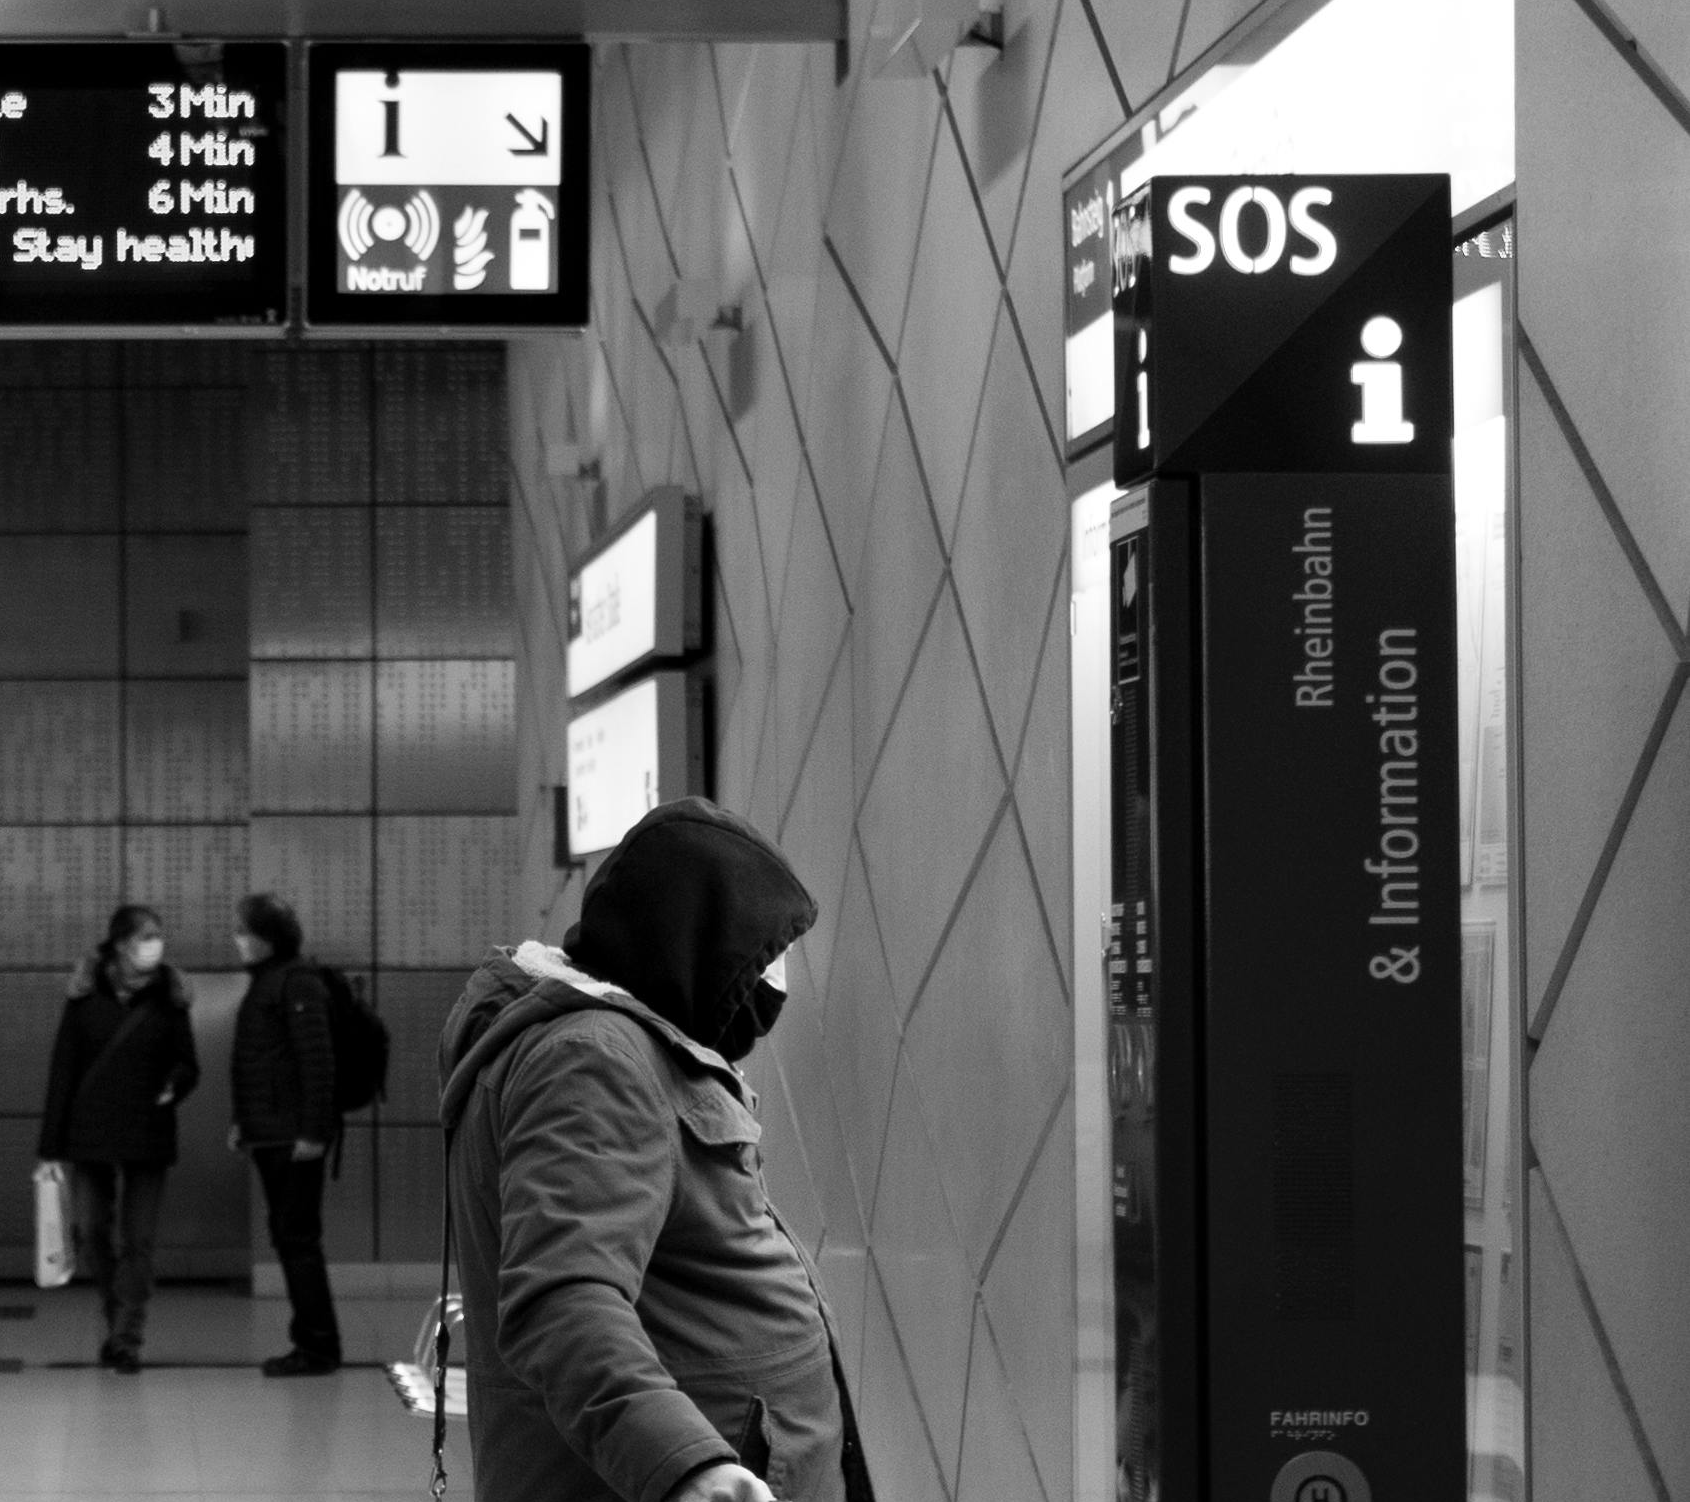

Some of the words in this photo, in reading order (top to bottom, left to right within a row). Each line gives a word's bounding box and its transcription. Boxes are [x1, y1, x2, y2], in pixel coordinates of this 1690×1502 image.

[148, 83, 175, 119] 3
[179, 83, 256, 119] Min
[148, 130, 175, 167] 4
[179, 130, 256, 167] Min
[148, 179, 175, 215] 6
[179, 179, 256, 215] Min
[12, 227, 103, 271] Stay
[1167, 185, 1338, 276] SOS
[347, 264, 428, 292] Notruf
[1292, 506, 1335, 709] Rheinbahn
[1363, 627, 1420, 926] Information
[1369, 946, 1421, 985] &
[1269, 1410, 1371, 1427] FAHRINFO
